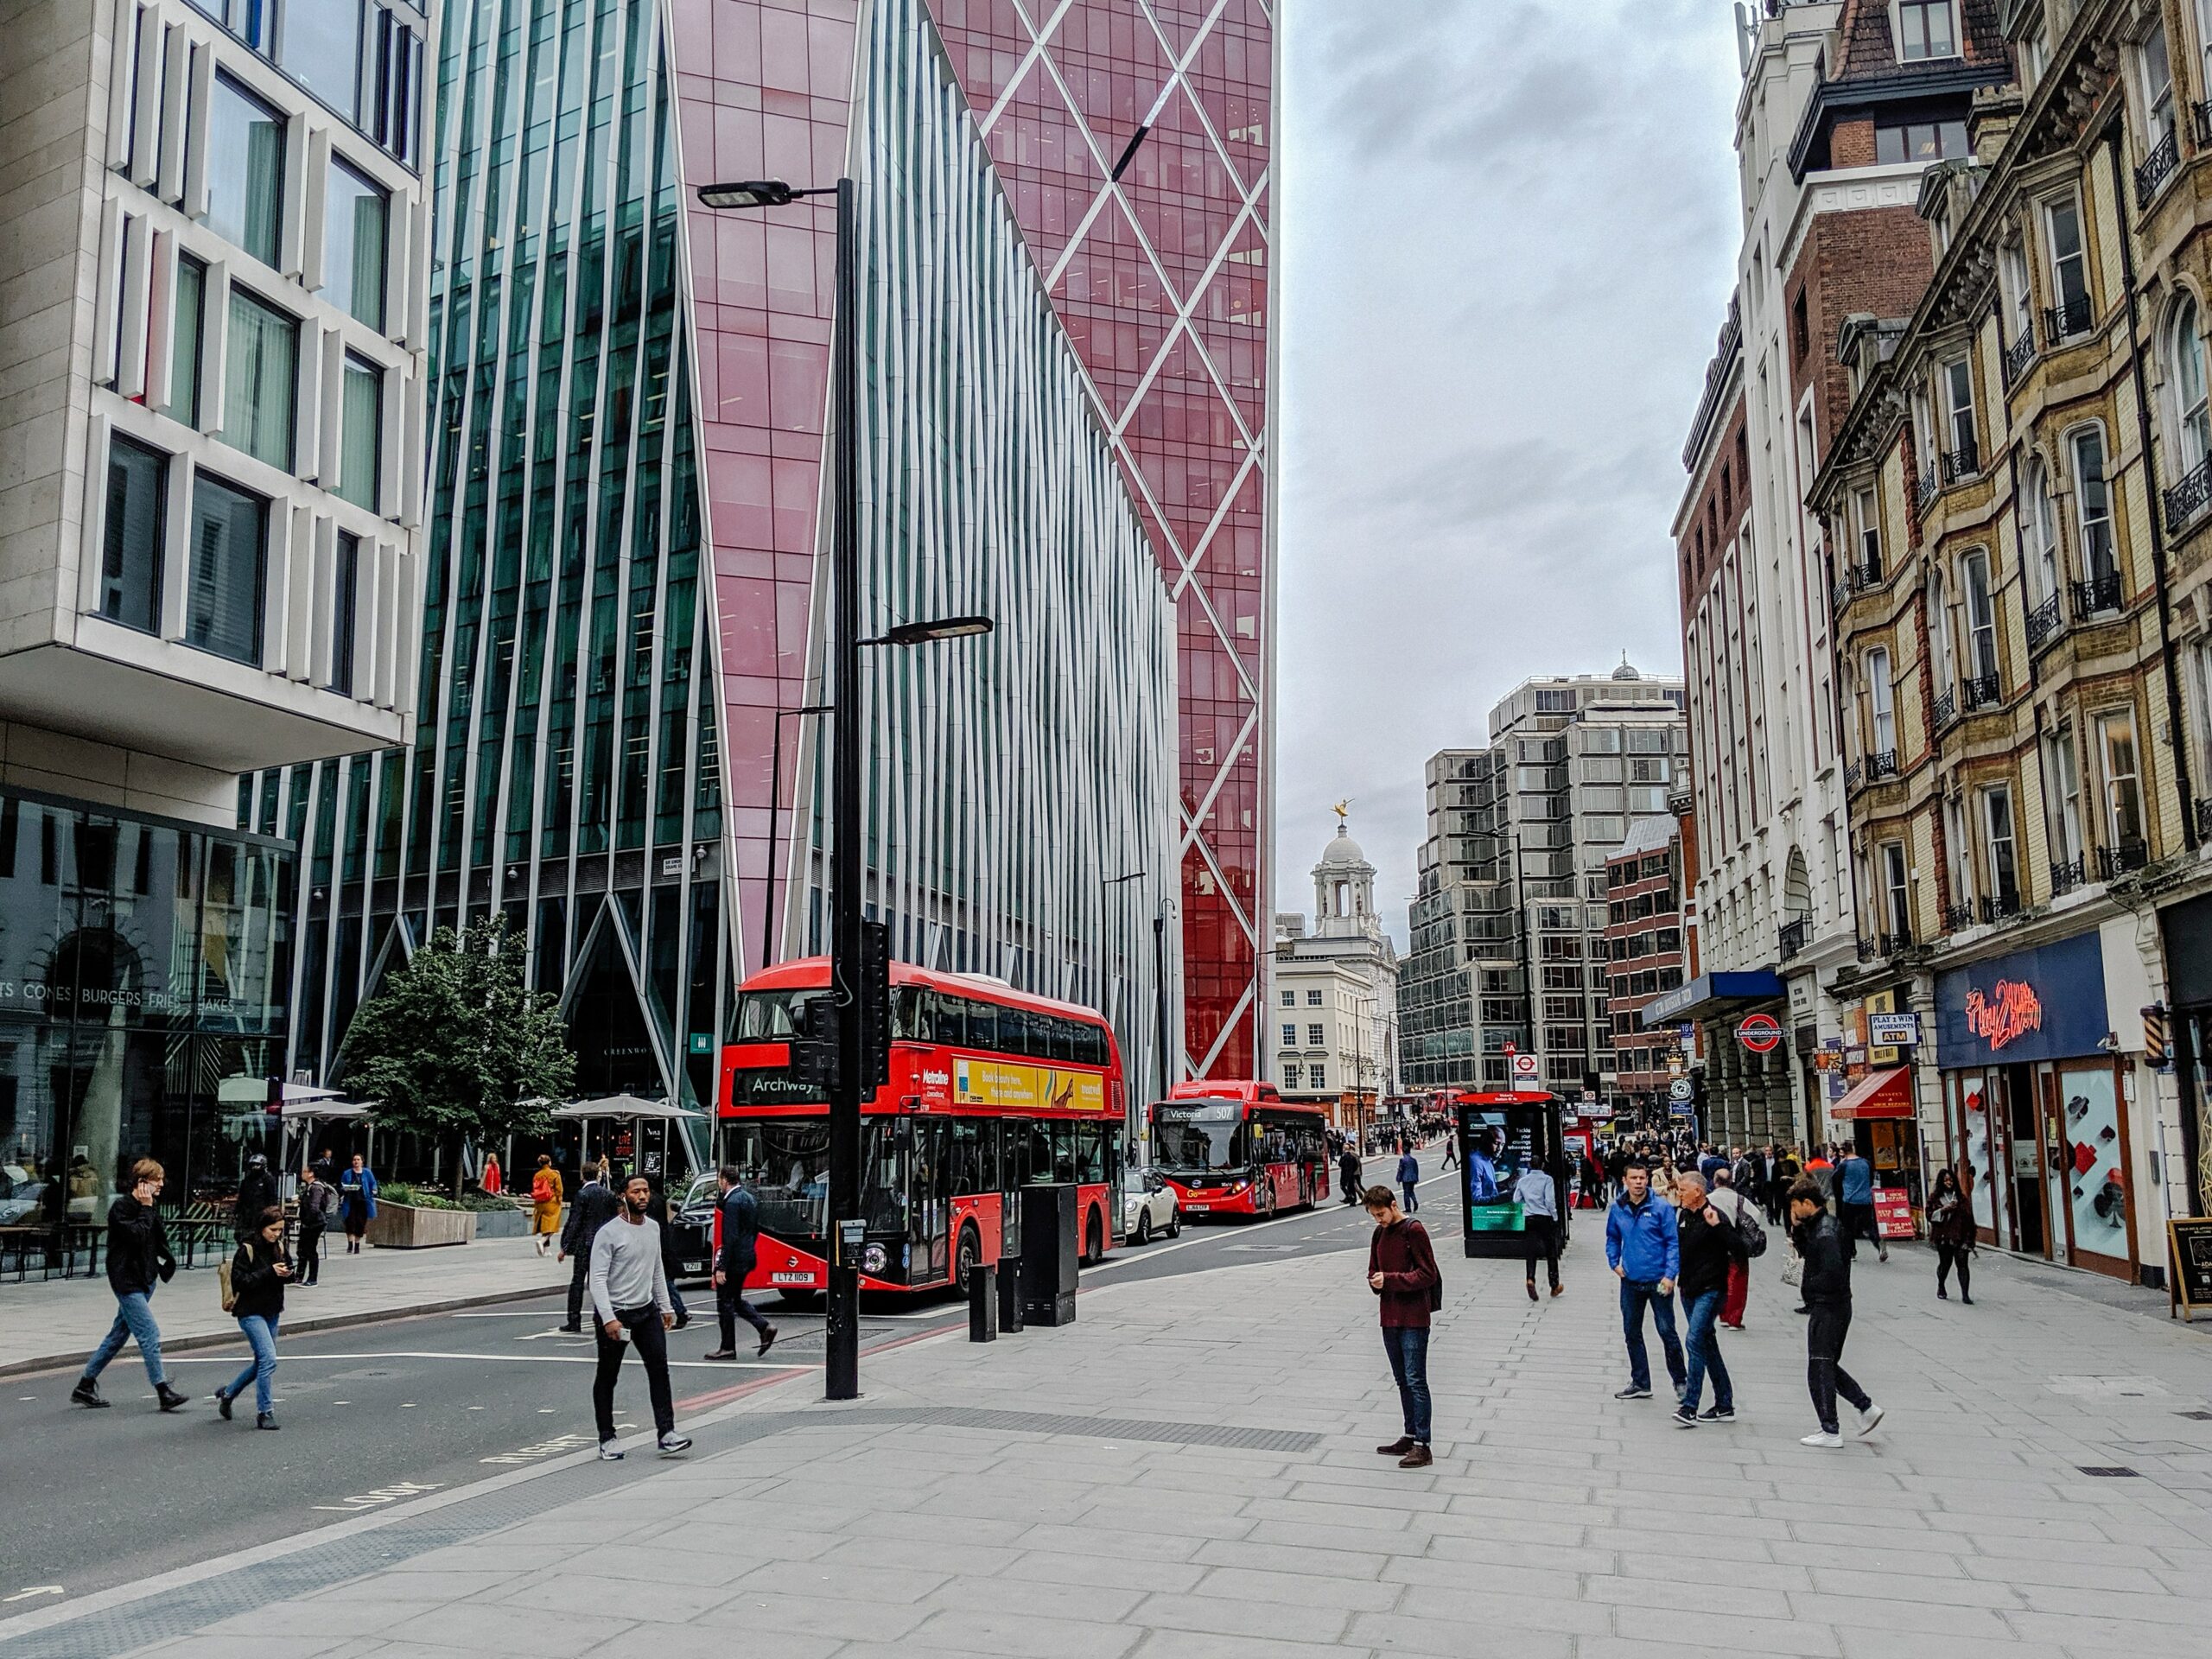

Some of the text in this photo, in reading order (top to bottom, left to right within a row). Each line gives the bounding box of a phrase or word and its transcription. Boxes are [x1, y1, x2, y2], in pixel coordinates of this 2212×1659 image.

[23, 983, 71, 1001] CONES
[82, 988, 141, 1006] BURGERS
[149, 993, 181, 1008] FRIES
[193, 995, 235, 1012] HAKES
[1883, 1032, 1906, 1042] ATM
[982, 1070, 994, 1083] Book
[752, 1077, 813, 1094] Archway
[1170, 1107, 1230, 1119] Victoria 507
[778, 1273, 809, 1281] LTZ 1109
[479, 1433, 600, 1464] RIGHT
[310, 1481, 445, 1511] LOOK
